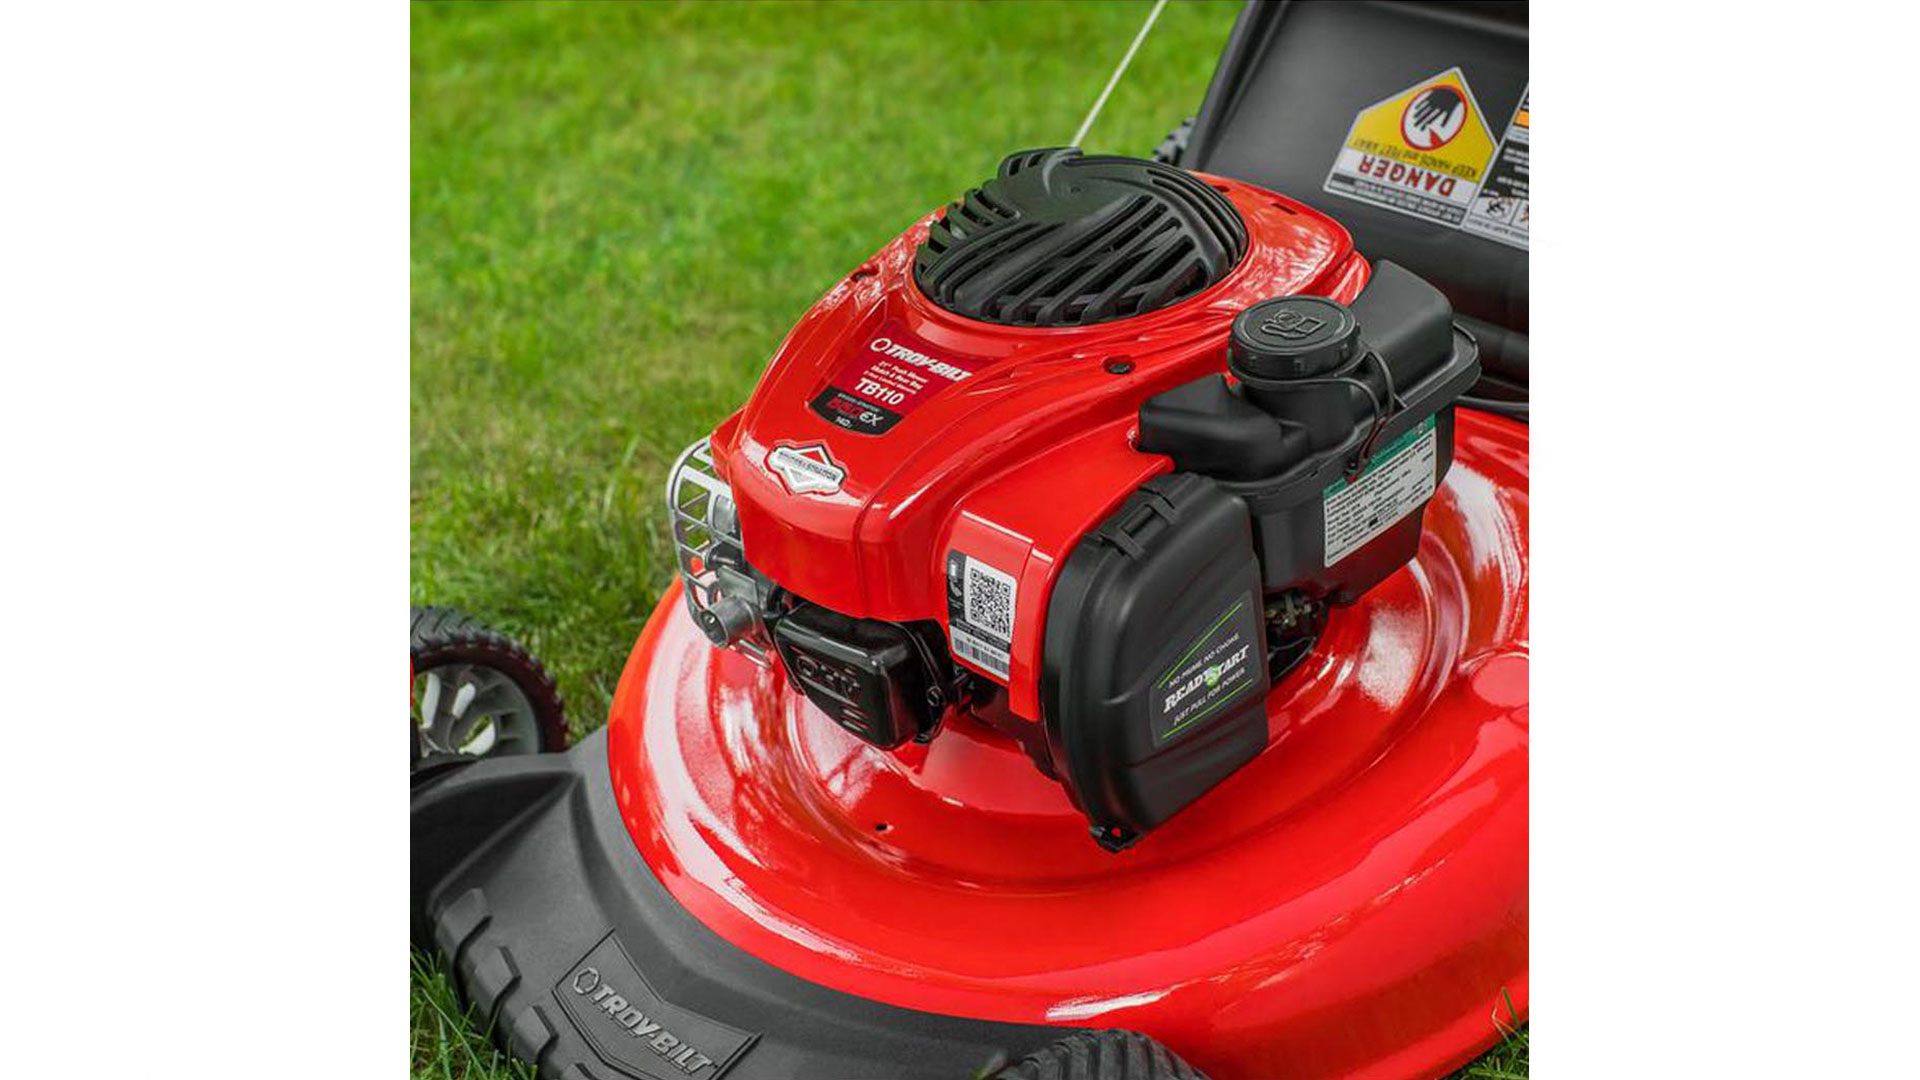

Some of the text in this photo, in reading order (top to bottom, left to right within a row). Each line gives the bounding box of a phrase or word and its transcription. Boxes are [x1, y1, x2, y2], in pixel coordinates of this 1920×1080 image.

[1359, 154, 1457, 197] DANGER
[884, 344, 973, 381] TROY-BILT
[855, 377, 905, 405] TB110
[592, 983, 713, 1074] TROY-BILT
